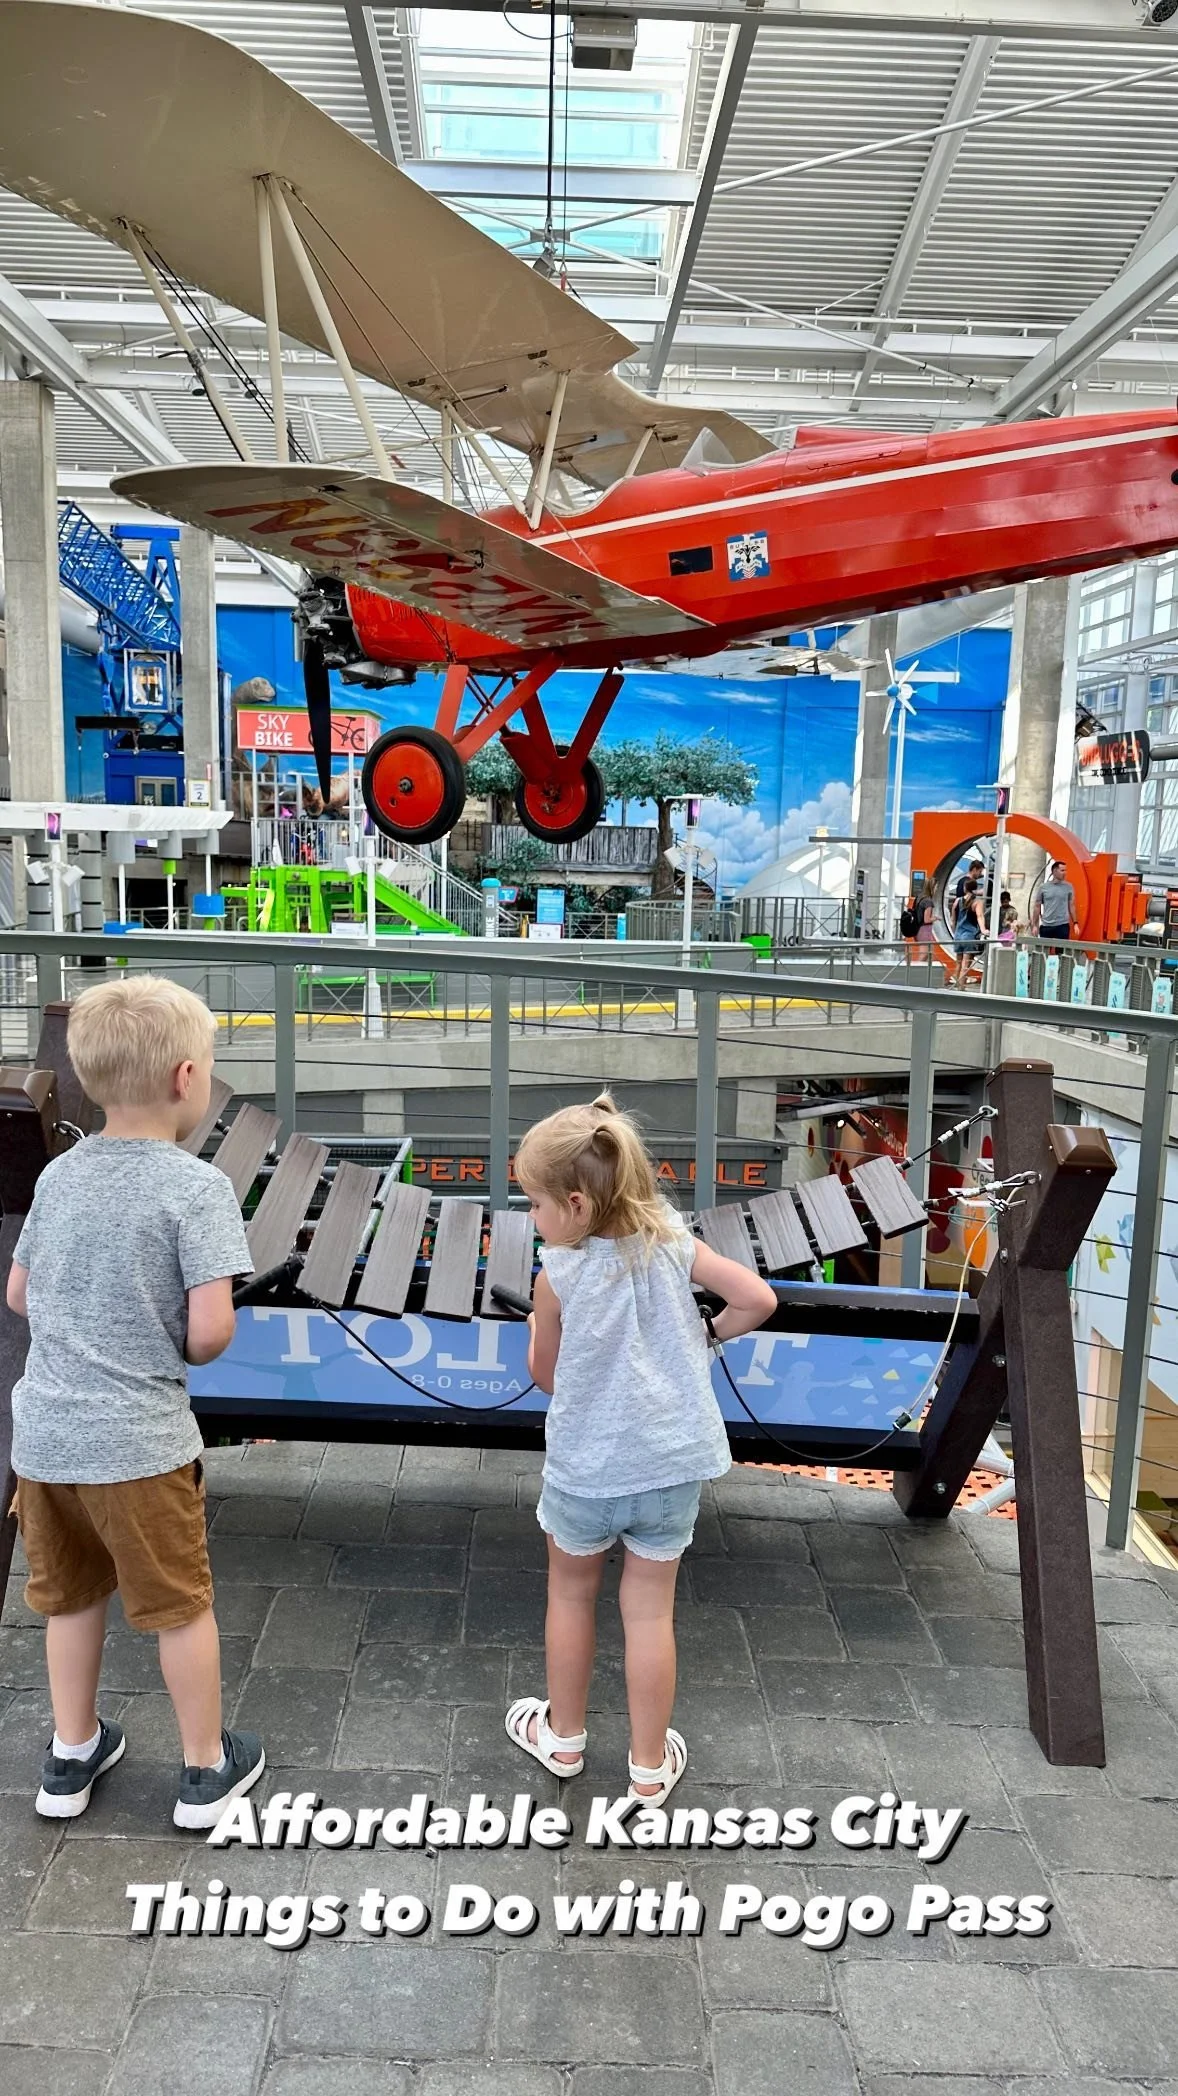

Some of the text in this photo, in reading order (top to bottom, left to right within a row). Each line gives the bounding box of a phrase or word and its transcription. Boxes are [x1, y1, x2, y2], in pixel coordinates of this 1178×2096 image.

[257, 713, 290, 731] SKY
[254, 731, 294, 747] BIKE
[196, 791, 203, 801] 2
